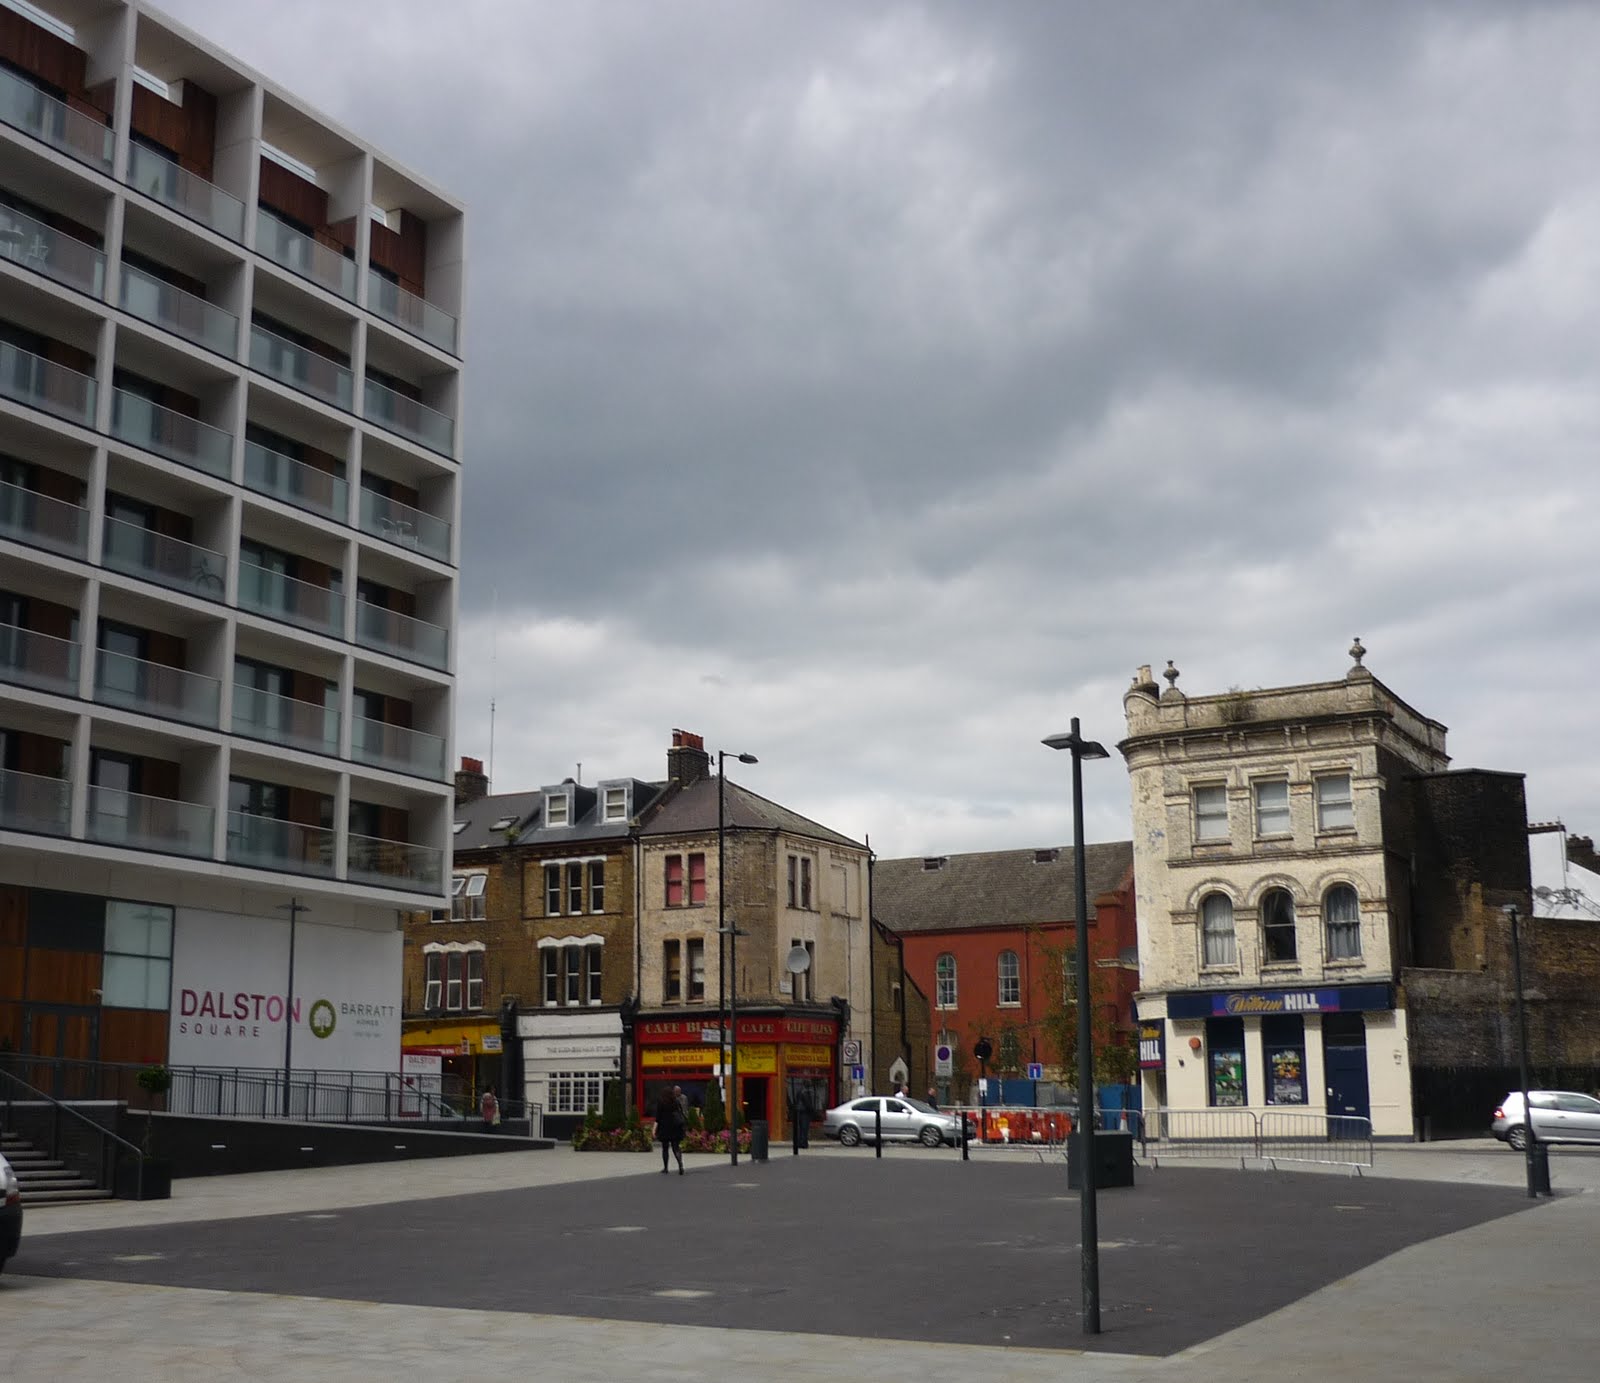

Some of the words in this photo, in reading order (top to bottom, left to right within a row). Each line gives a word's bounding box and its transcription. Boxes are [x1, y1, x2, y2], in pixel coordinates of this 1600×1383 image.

[181, 988, 301, 1023] DALSTON
[1283, 993, 1319, 1010] HILL
[341, 1003, 395, 1017] BARRATT
[180, 1022, 260, 1038] SQUARE
[645, 1022, 680, 1034] CAFE
[685, 1020, 727, 1033] BLIS
[741, 1023, 775, 1033] CAFE
[1140, 1040, 1161, 1061] HILL
